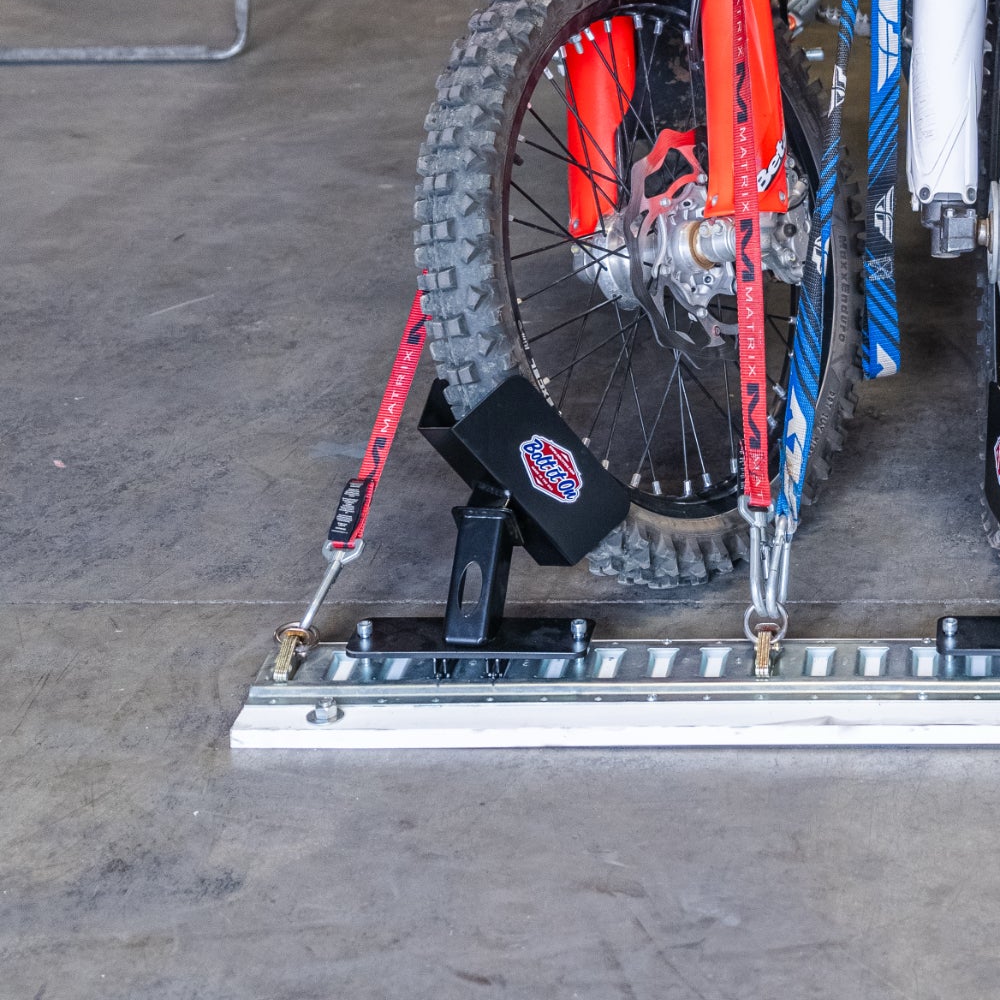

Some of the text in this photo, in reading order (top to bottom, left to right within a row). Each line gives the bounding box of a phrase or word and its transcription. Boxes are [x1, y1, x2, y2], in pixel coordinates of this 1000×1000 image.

[739, 126, 750, 213] MATRIX
[744, 287, 757, 376] MATRIX
[381, 351, 413, 433] MATRIX
[523, 439, 557, 470] Bolt
[558, 480, 576, 500] On
